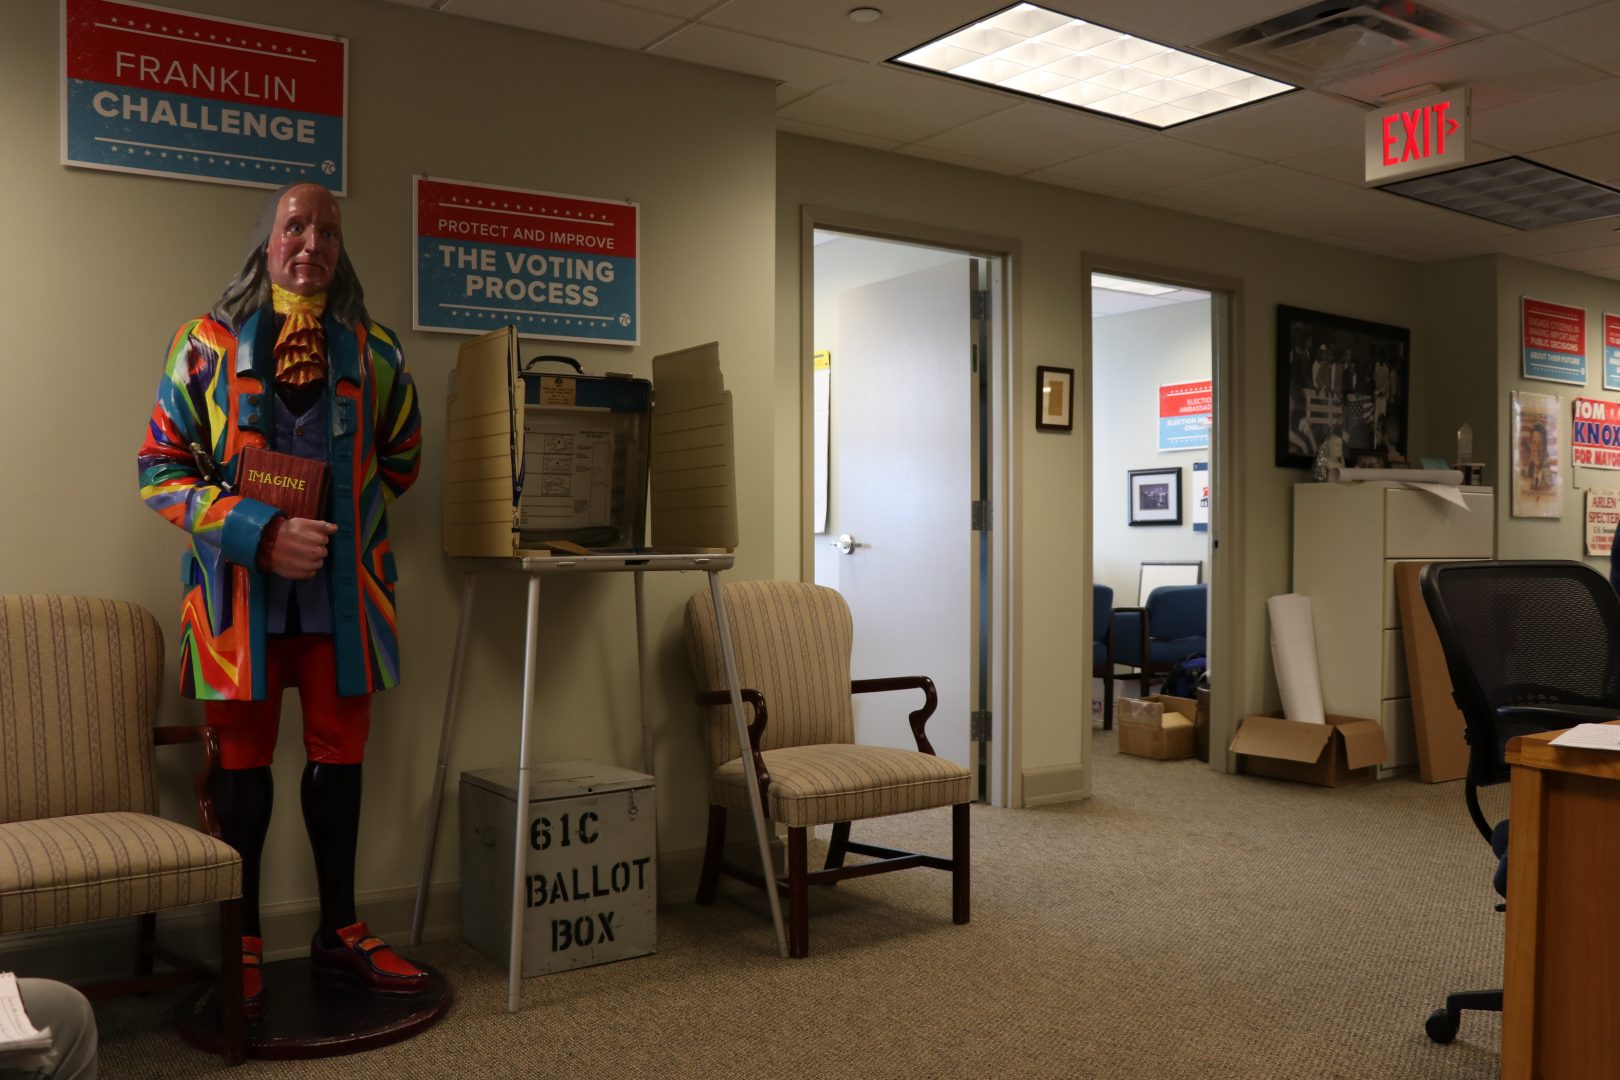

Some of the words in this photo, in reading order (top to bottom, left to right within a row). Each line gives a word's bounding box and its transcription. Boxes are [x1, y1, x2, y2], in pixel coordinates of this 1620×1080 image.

[116, 51, 296, 103] FRANKLIN
[92, 90, 316, 144] CHALLENGE
[1383, 101, 1450, 166] EXIT
[438, 219, 508, 238] PROTECT
[513, 227, 545, 242] AND
[550, 232, 615, 249] IMPROVE
[438, 245, 496, 272] THE
[505, 251, 615, 283] VOTING
[466, 274, 599, 307] PROCESS
[1179, 404, 1212, 413] AMBASSAD
[1187, 397, 1212, 406] ELECTIO
[1575, 400, 1606, 421] TOM
[1574, 421, 1620, 447] KNOX
[1575, 448, 1592, 465] FOR
[248, 469, 306, 490] IMAGINE
[1592, 496, 1616, 508] ARLEN
[530, 811, 599, 851] 61C
[526, 857, 650, 908] BALLOT
[551, 911, 615, 952] BOX
